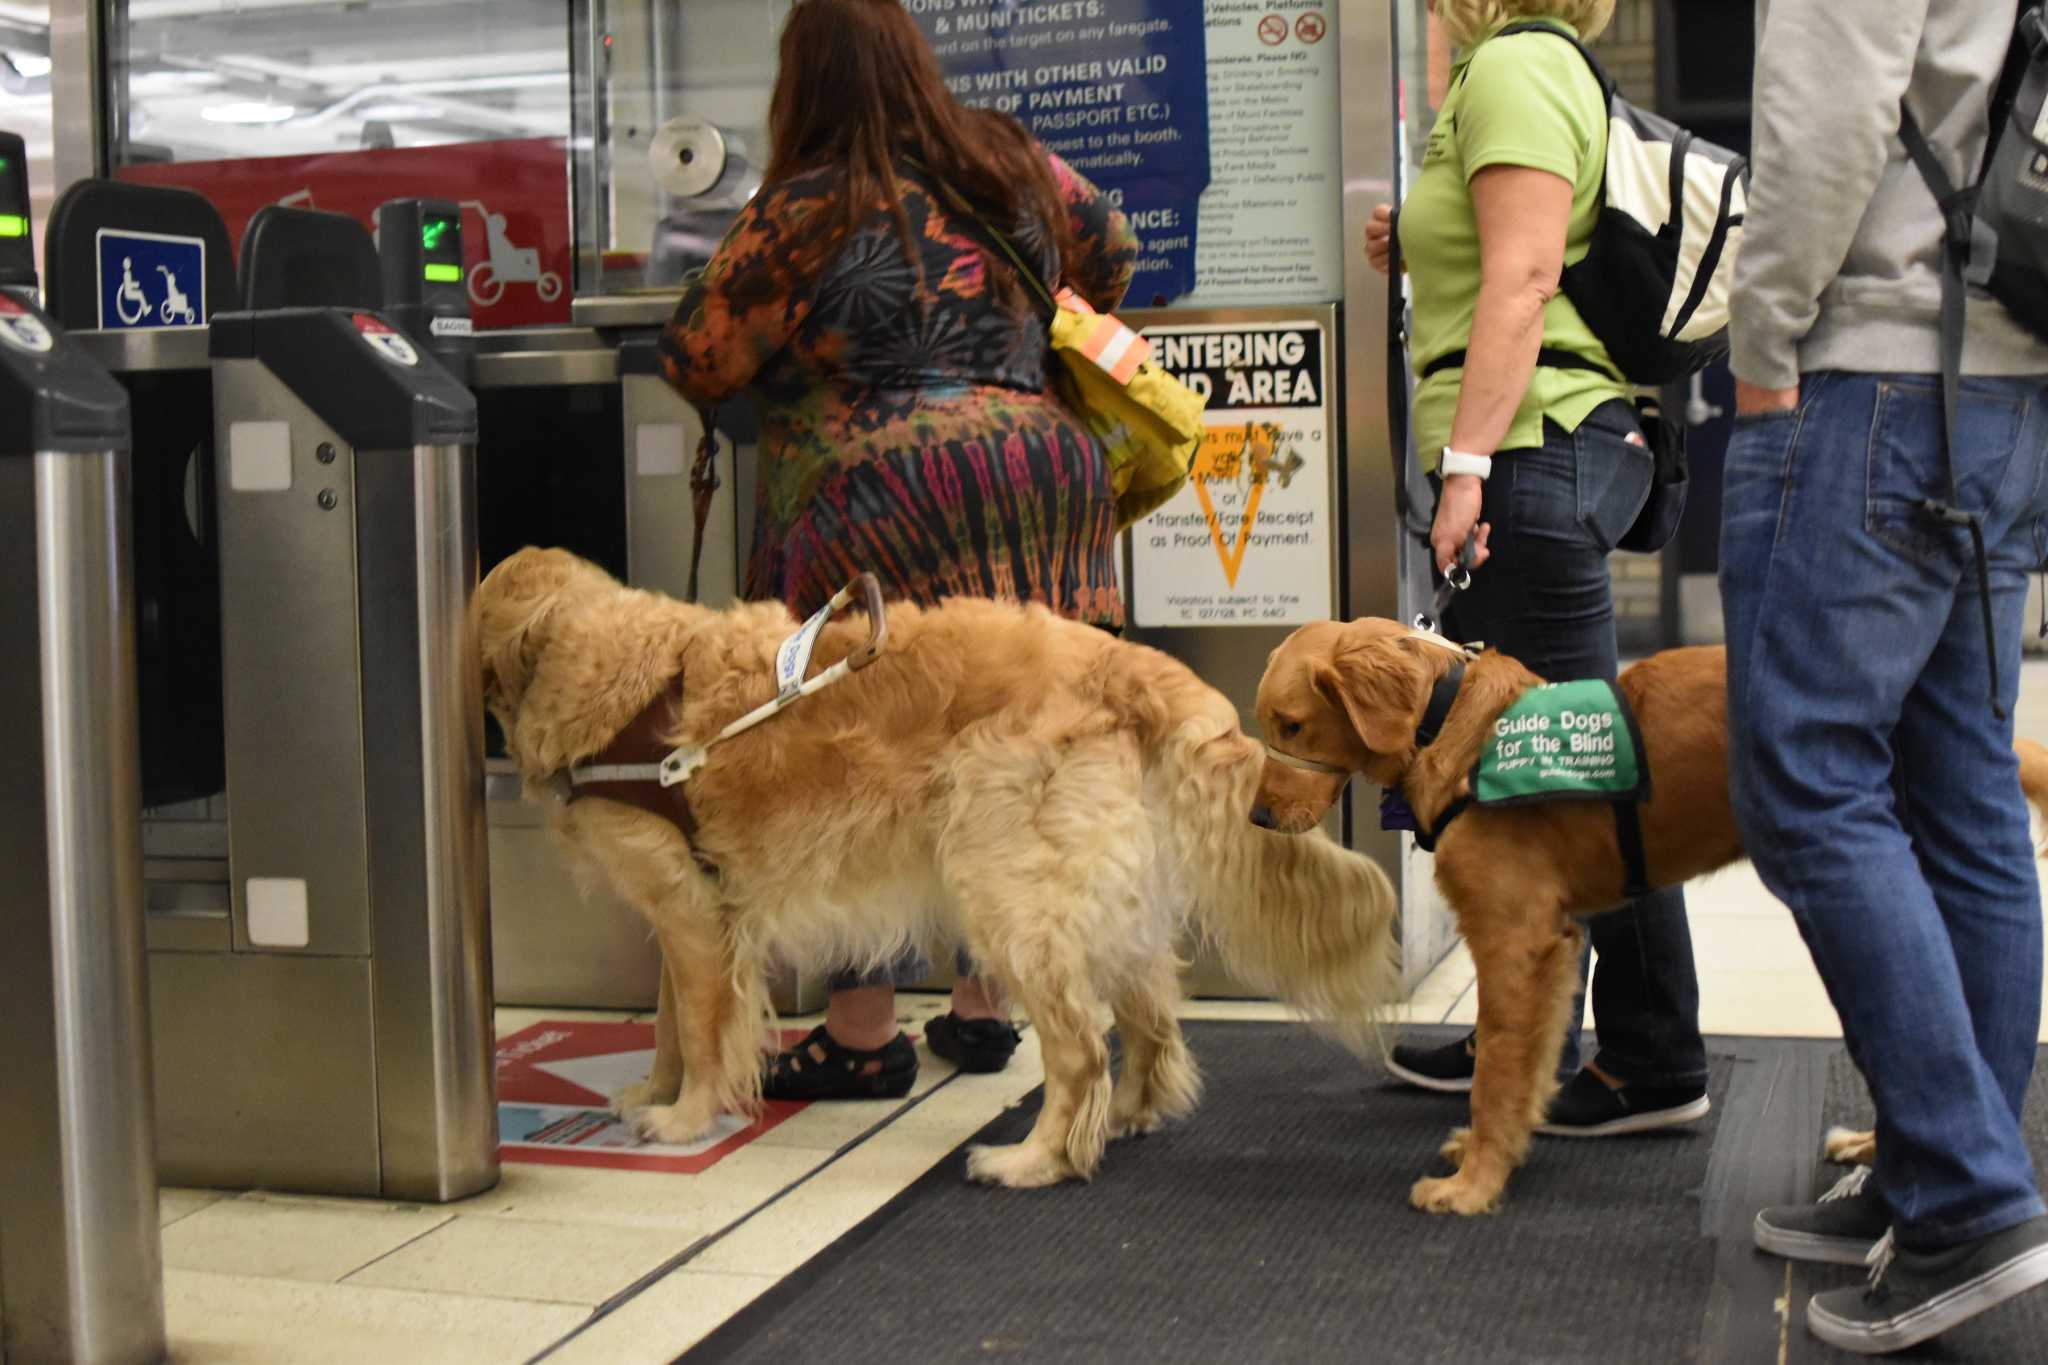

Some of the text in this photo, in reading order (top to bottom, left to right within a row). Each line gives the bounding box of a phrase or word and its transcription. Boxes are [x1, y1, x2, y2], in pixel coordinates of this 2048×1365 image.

[935, 1, 1106, 34] & MUNI TICKETS:
[960, 40, 980, 52] on
[1010, 31, 1052, 50] target
[1055, 30, 1075, 43] on
[1078, 26, 1106, 41] any
[975, 68, 1029, 92] WITH
[1034, 60, 1103, 86] OTHER
[1106, 54, 1168, 78] VALID
[995, 93, 1024, 113] OF
[1028, 83, 1126, 110] PAYMENT
[1032, 102, 1171, 131] PASSPORT ETC.)
[1087, 135, 1104, 149] to
[1107, 131, 1131, 147] the
[1134, 127, 1182, 145] booth.
[1147, 235, 1189, 255] agent
[1148, 331, 1306, 370] ENTERING
[1226, 368, 1318, 406] AREA
[1257, 510, 1315, 527] Receipt
[1150, 535, 1168, 549] as
[1173, 532, 1212, 548] Proof
[1218, 532, 1238, 546] Of
[1494, 710, 1614, 738] Guide Dogs
[1495, 731, 1614, 760] for the Blind
[1496, 755, 1537, 773] PUPPY
